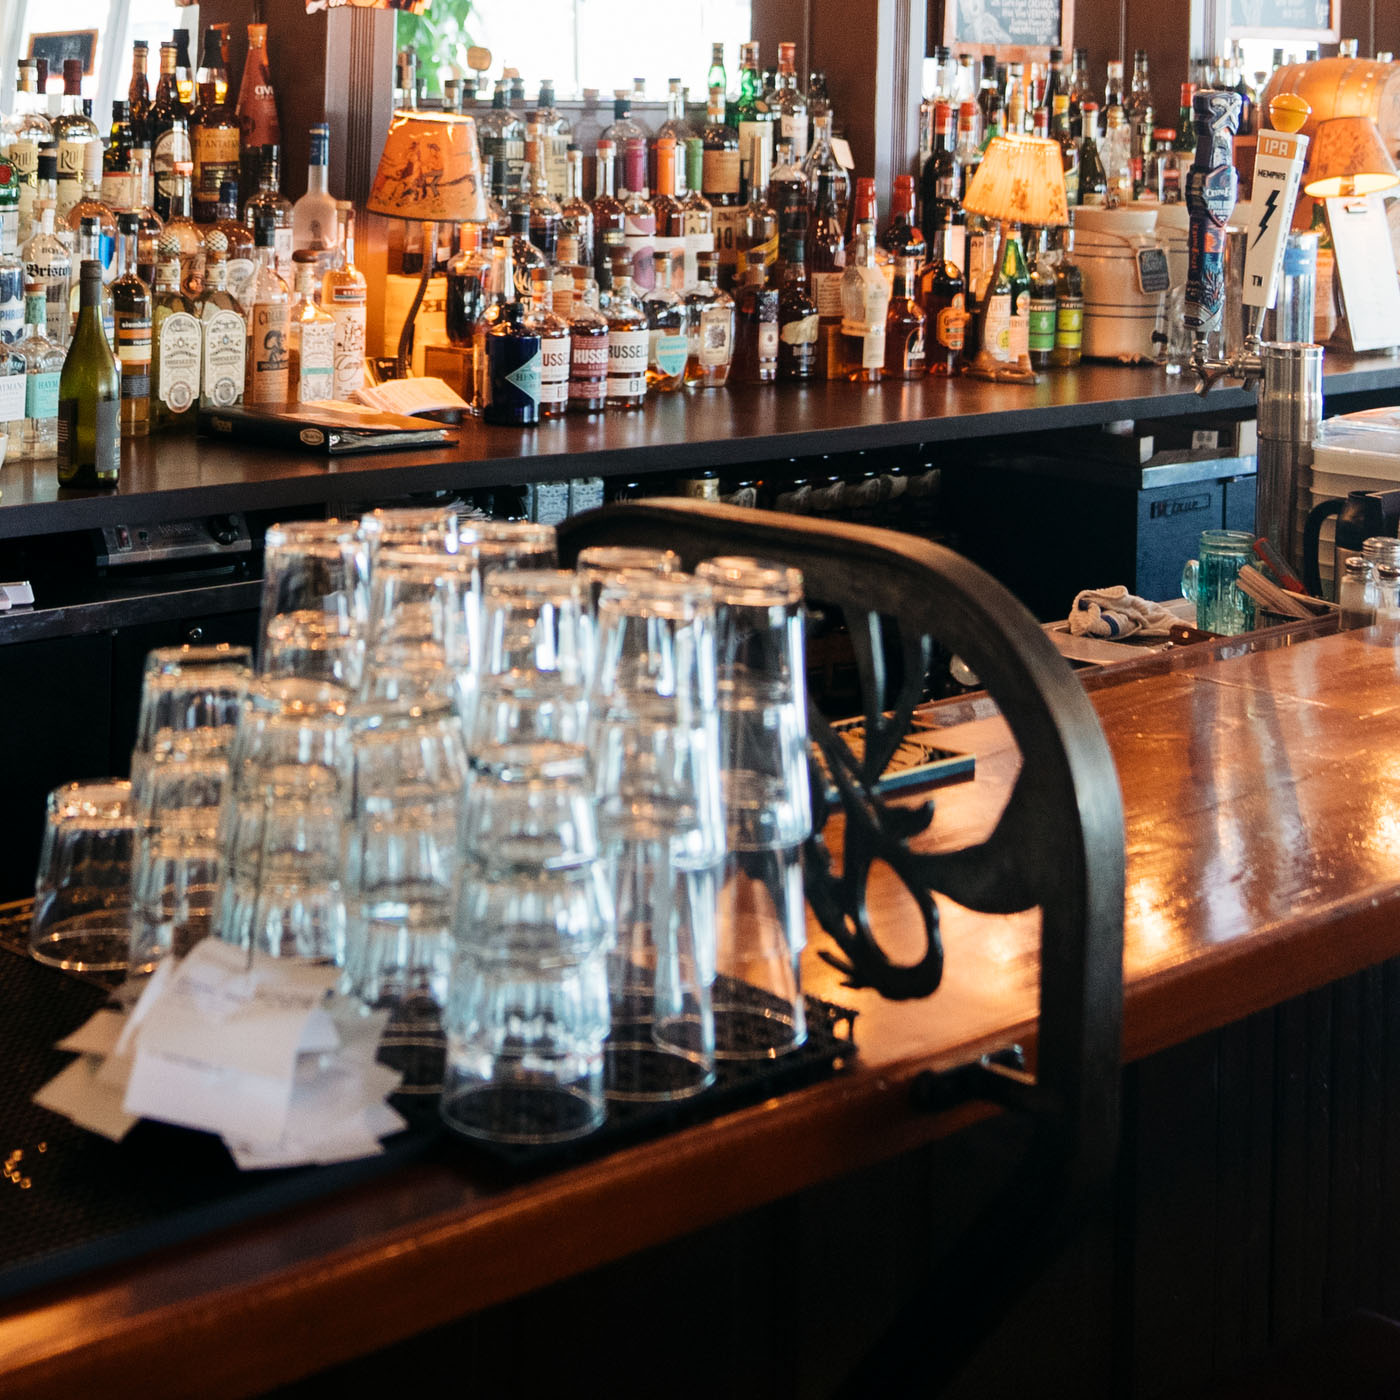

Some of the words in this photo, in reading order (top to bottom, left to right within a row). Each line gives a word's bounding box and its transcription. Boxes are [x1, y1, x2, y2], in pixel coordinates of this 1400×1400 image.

[1265, 140, 1288, 157] IPA
[1257, 169, 1286, 182] MEMPHIS
[1252, 275, 1264, 287] TN
